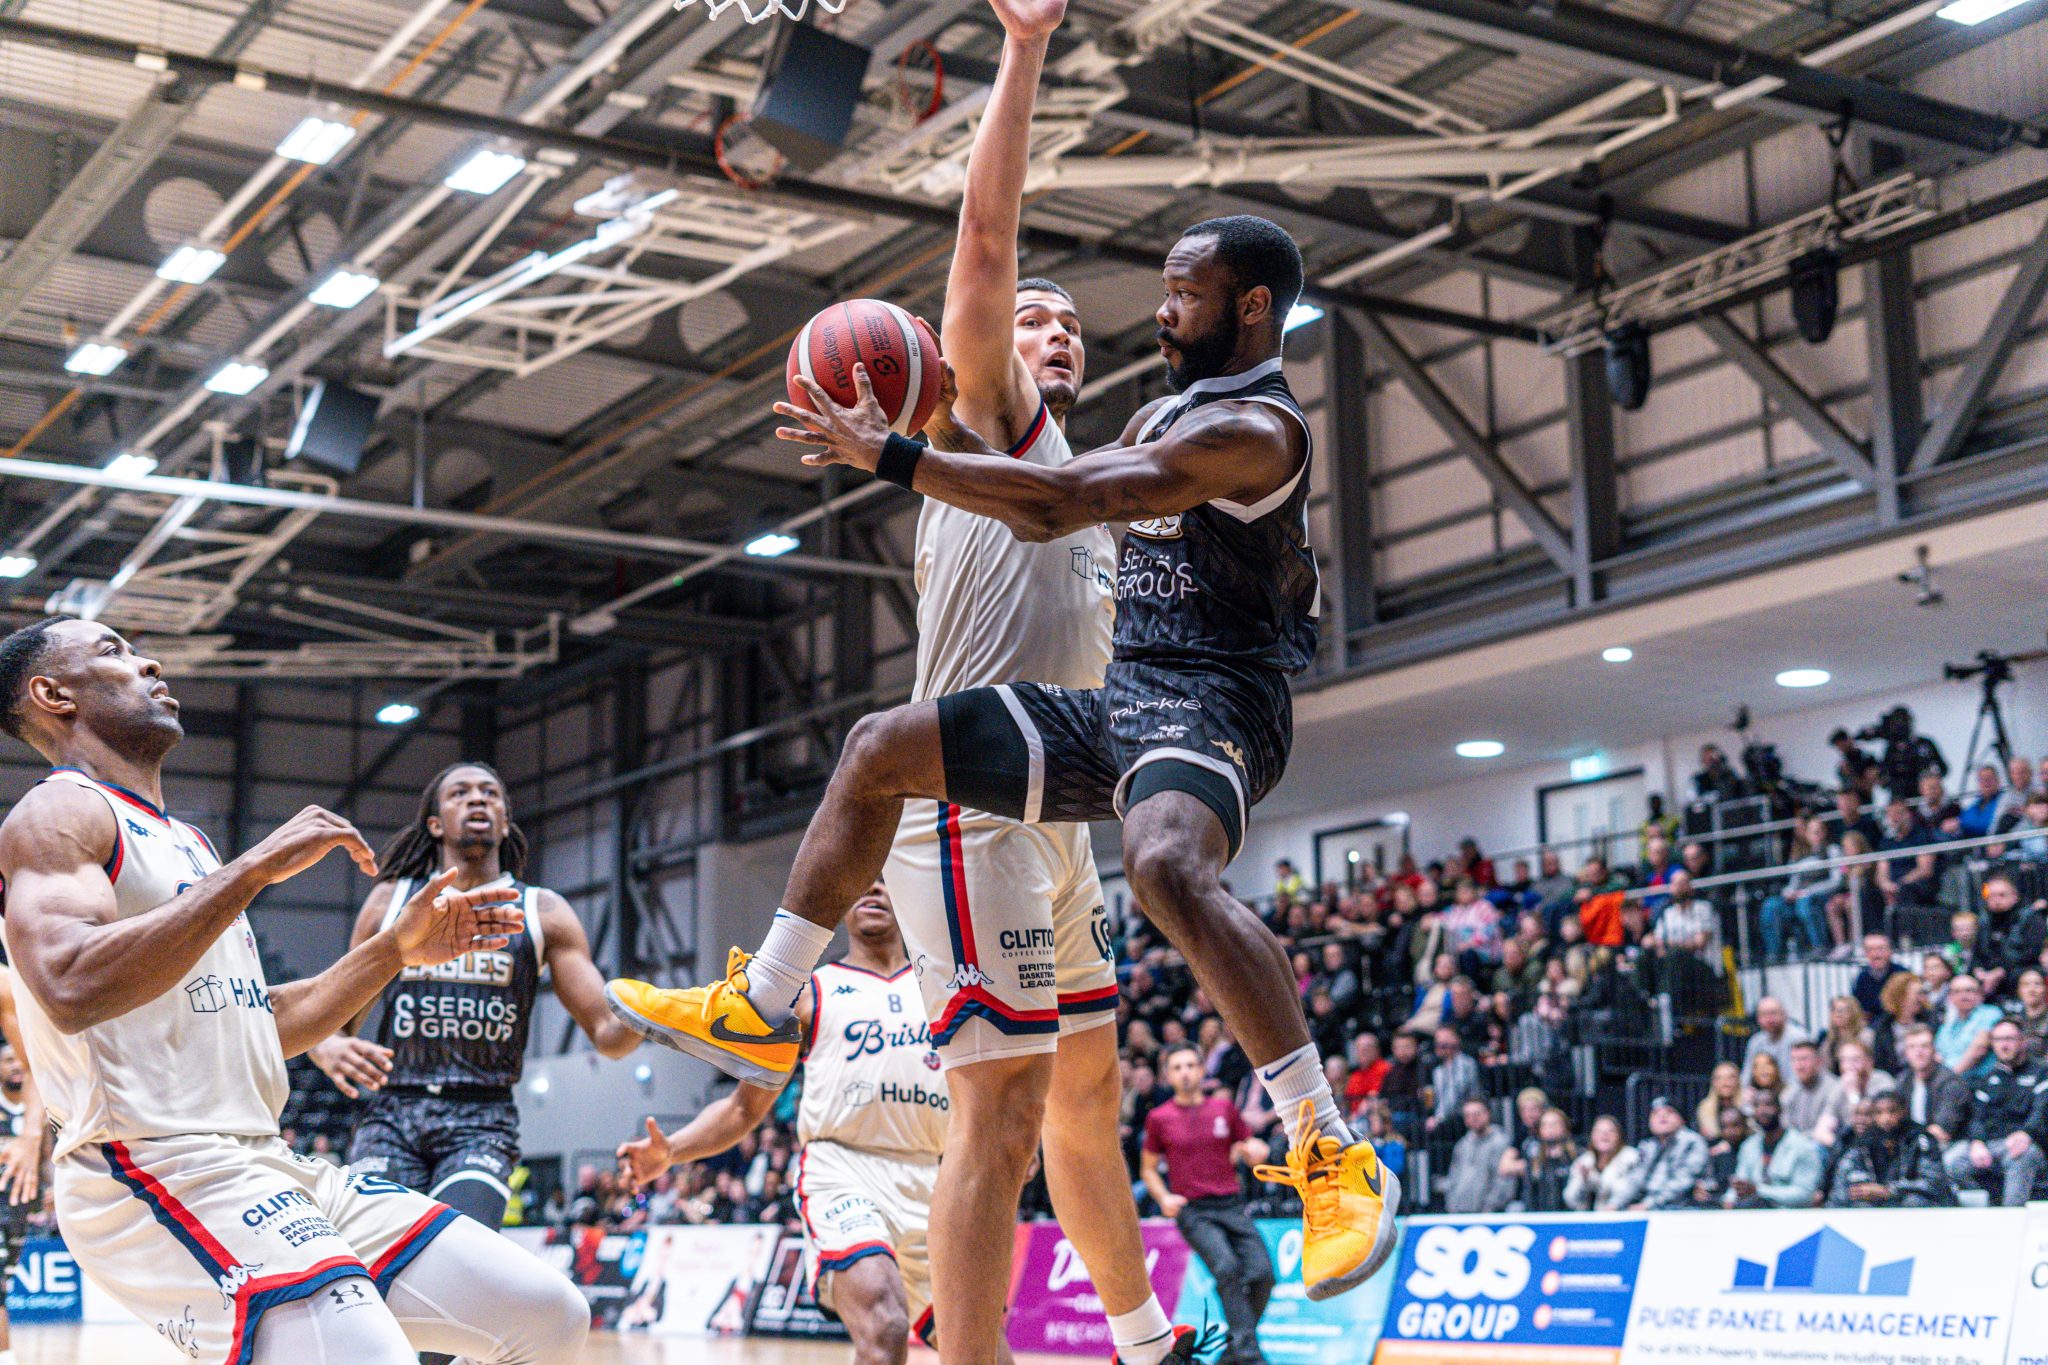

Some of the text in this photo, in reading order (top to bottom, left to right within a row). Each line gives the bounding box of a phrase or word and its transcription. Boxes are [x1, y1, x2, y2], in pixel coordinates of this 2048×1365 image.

[823, 325, 850, 389] molten
[1000, 928, 1054, 950] CLIFTO
[1018, 962, 1055, 972] BRITIS
[1019, 971, 1056, 981] BASKETBA
[229, 977, 273, 1014] Hub
[1020, 979, 1056, 989] LEAGU
[419, 995, 518, 1025] SERIÖS
[887, 993, 903, 1014] 8
[420, 1017, 513, 1043] GROUP
[844, 1019, 932, 1062] Brist
[881, 1082, 949, 1111] Huboo
[241, 1190, 312, 1228] CLIFTO
[4, 1250, 78, 1294] NE
[1406, 1225, 1538, 1300] SOS
[1397, 1301, 1520, 1340] GROUP
[1638, 1305, 1701, 1329] PURE
[1706, 1307, 1787, 1333] PANEL
[1795, 1311, 1999, 1340] MANAGEMENT
